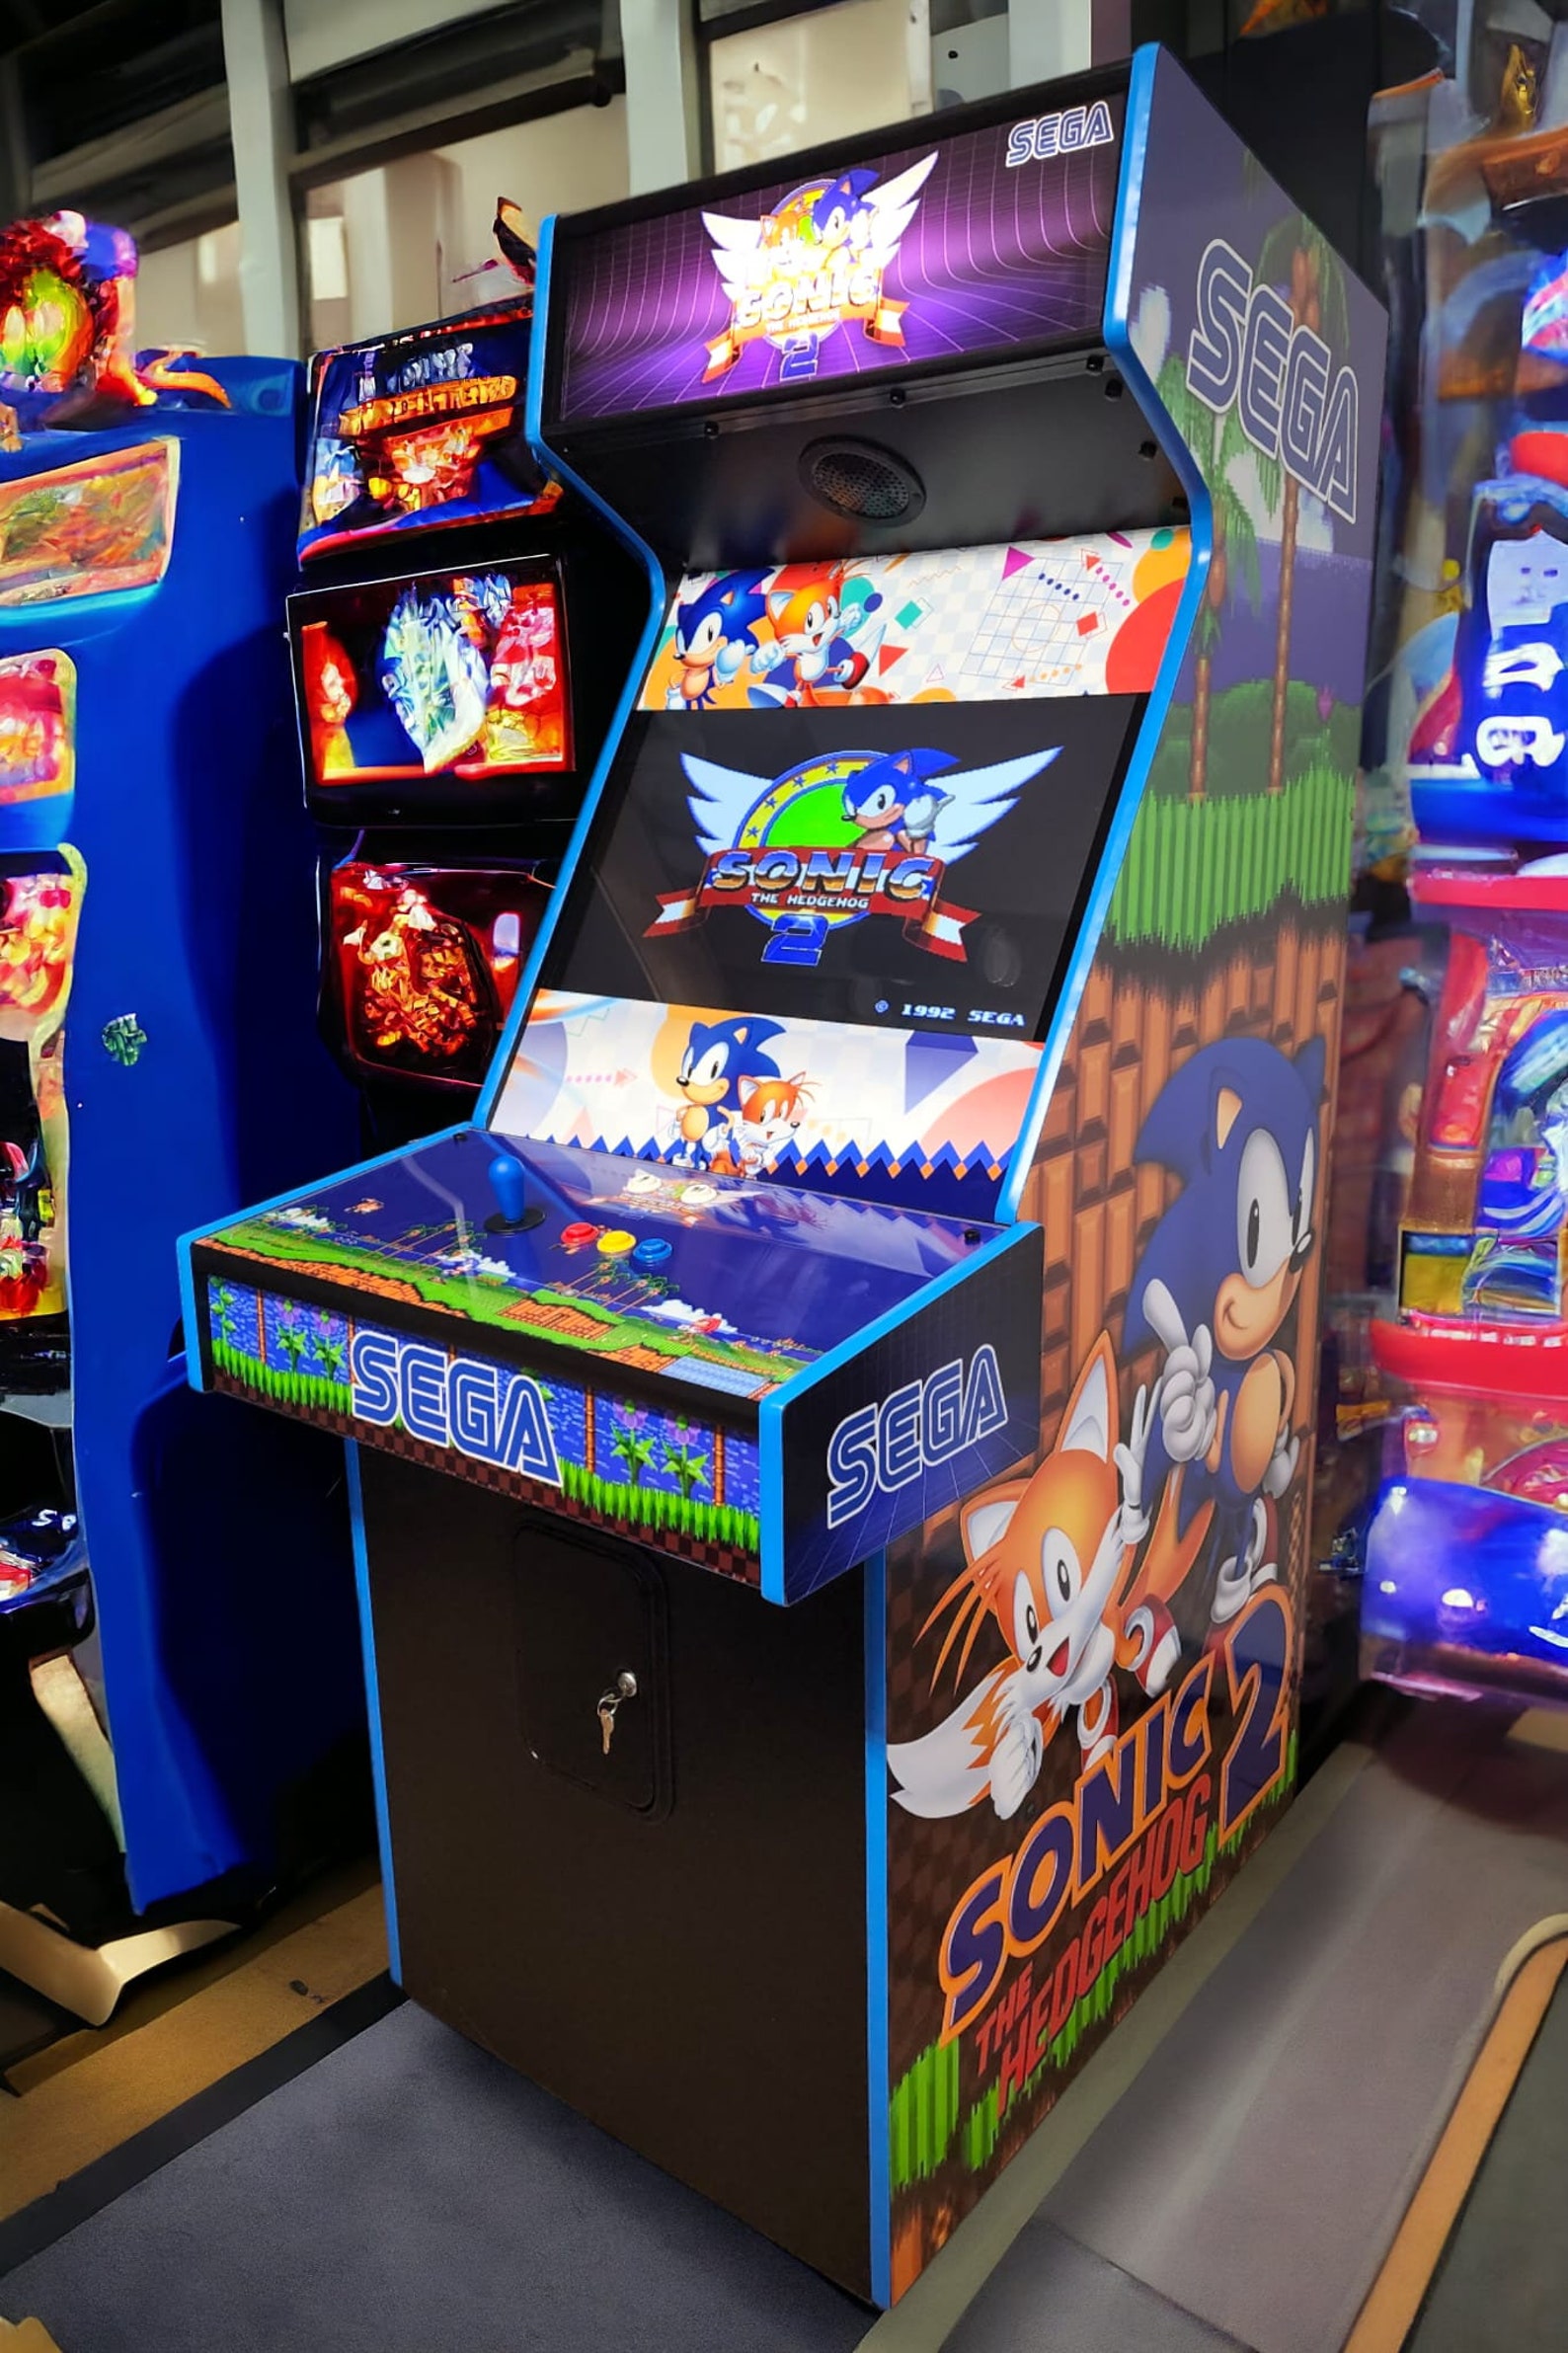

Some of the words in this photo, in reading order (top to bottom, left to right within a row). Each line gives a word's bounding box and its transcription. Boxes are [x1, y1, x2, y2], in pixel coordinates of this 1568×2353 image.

[1005, 100, 1115, 169] SEGA
[738, 267, 881, 329] SONIC
[779, 330, 819, 382] 2
[1185, 238, 1359, 524] SEGA
[711, 850, 936, 900] SONIC
[750, 892, 779, 904] THE
[786, 894, 870, 909] HEDGEHOG
[760, 913, 829, 967] 2
[901, 1003, 957, 1020] 1992
[966, 1009, 1026, 1027] SEGA
[352, 1329, 565, 1488] SEGA
[826, 1343, 1009, 1530] SEGA
[938, 1653, 1215, 2049] SONIC
[1217, 1585, 1294, 1848] 2
[996, 1773, 1213, 2120] HEDGEHOG
[975, 1959, 1034, 2078] THE
